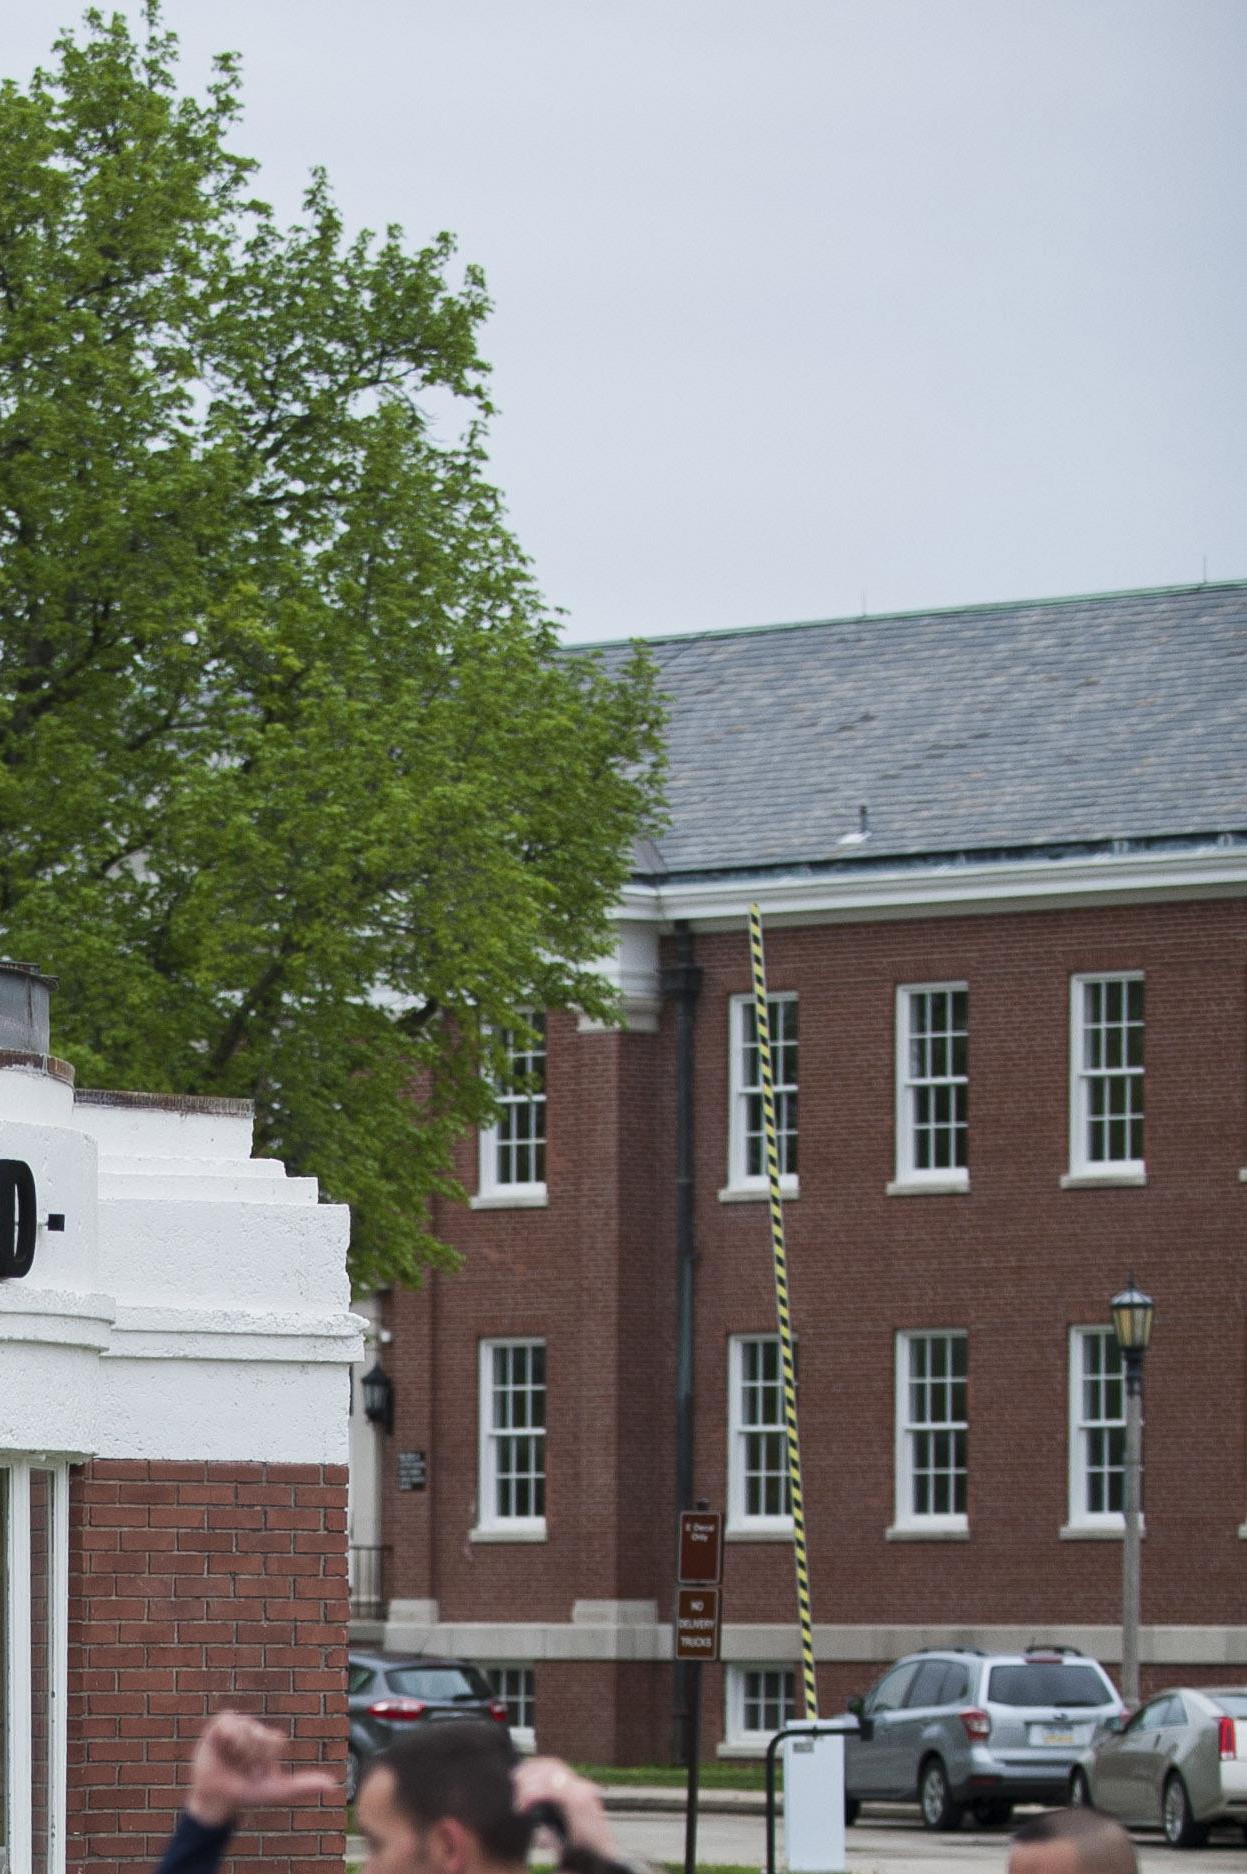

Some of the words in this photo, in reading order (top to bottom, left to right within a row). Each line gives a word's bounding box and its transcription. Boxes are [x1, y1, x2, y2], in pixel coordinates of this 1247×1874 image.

[691, 1600, 705, 1612] NO
[679, 1618, 715, 1630] DELIVERY
[681, 1636, 712, 1648] TRUCKS
